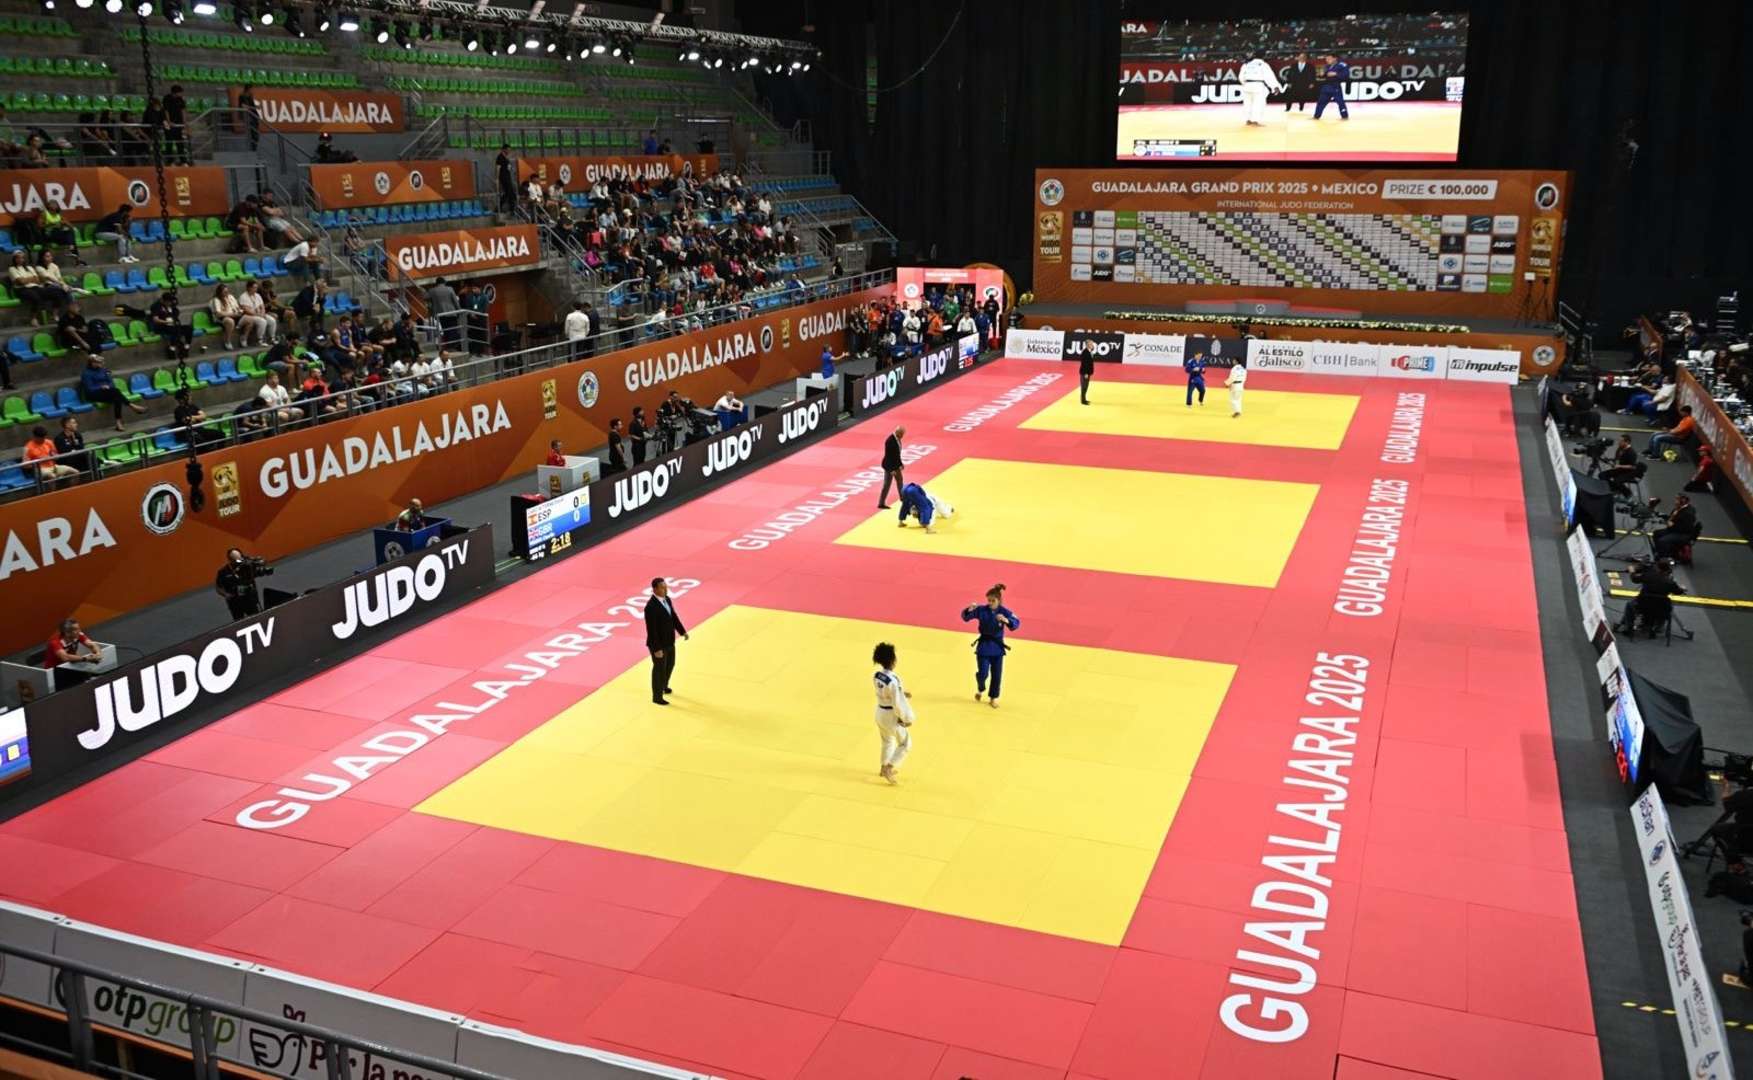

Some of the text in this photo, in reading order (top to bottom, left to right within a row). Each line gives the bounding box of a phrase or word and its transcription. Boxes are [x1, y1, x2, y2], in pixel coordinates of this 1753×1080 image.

[1192, 85, 1245, 103] JUD
[1341, 81, 1403, 100] UDO
[1092, 182, 1378, 195] GUADALAJARA GRAND PRIX 2025 MEXICO
[1217, 200, 1354, 209] INTERNATIONAL JUDO FEDERATION
[1390, 184, 1425, 194] PRIZE
[1428, 184, 1437, 194] €
[398, 235, 530, 271] GUADALAJARA
[625, 333, 757, 393] GUADALAJARA
[1026, 344, 1061, 354] México
[1144, 344, 1182, 353] CONADE
[1350, 356, 1377, 366] Bank
[1465, 360, 1518, 373] impulse
[917, 351, 947, 385] JUDO
[863, 371, 897, 408] JUDO
[778, 399, 828, 444] JUDO TV
[260, 399, 511, 498] GUADALAJARA
[702, 424, 763, 477] JUDO TV
[607, 464, 670, 518] JUDO
[668, 456, 683, 476] TV
[1333, 478, 1409, 616] GUADALAJARA 2025
[332, 554, 446, 640] JUDO
[440, 540, 470, 571] TV
[77, 617, 277, 750] JUDO TV
[236, 621, 631, 829] GUADALAJARA
[1219, 652, 1370, 1044] GUADALAJARA 2025
[94, 984, 236, 1044] otpgrop
